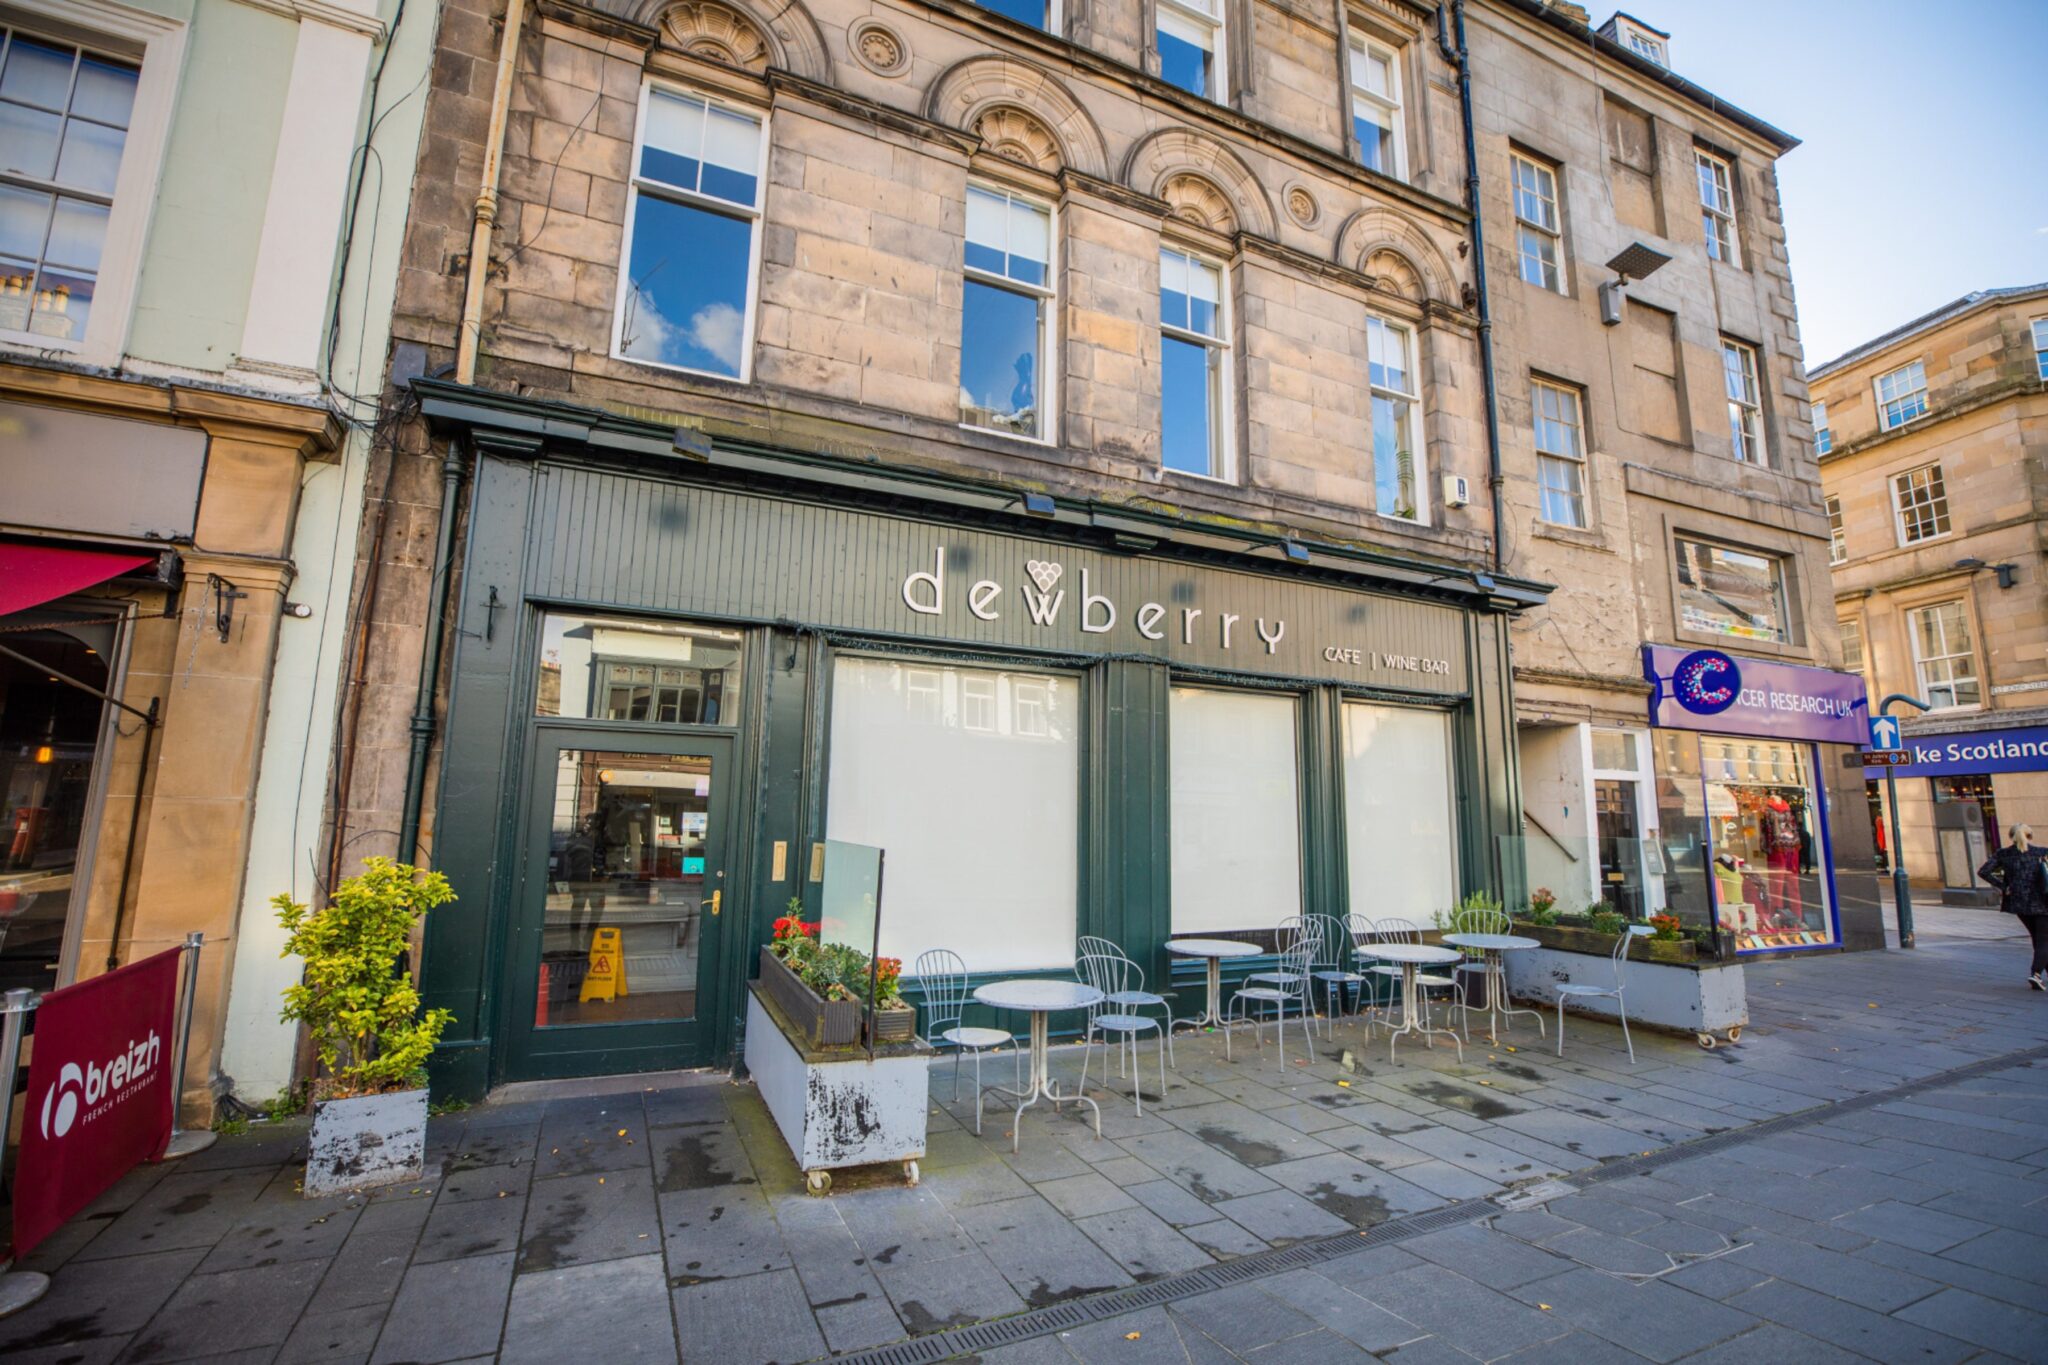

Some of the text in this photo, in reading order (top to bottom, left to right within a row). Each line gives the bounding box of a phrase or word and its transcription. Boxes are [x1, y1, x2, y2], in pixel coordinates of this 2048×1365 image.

[902, 546, 1284, 655] dewberry
[1324, 646, 1450, 675] CAFE WINE BAR
[1736, 688, 1854, 717] CER RESEARCH UK
[1915, 745, 1942, 763] ke
[85, 1028, 160, 1106] breizh
[82, 1069, 158, 1126] FRENCH RESTAURANT
